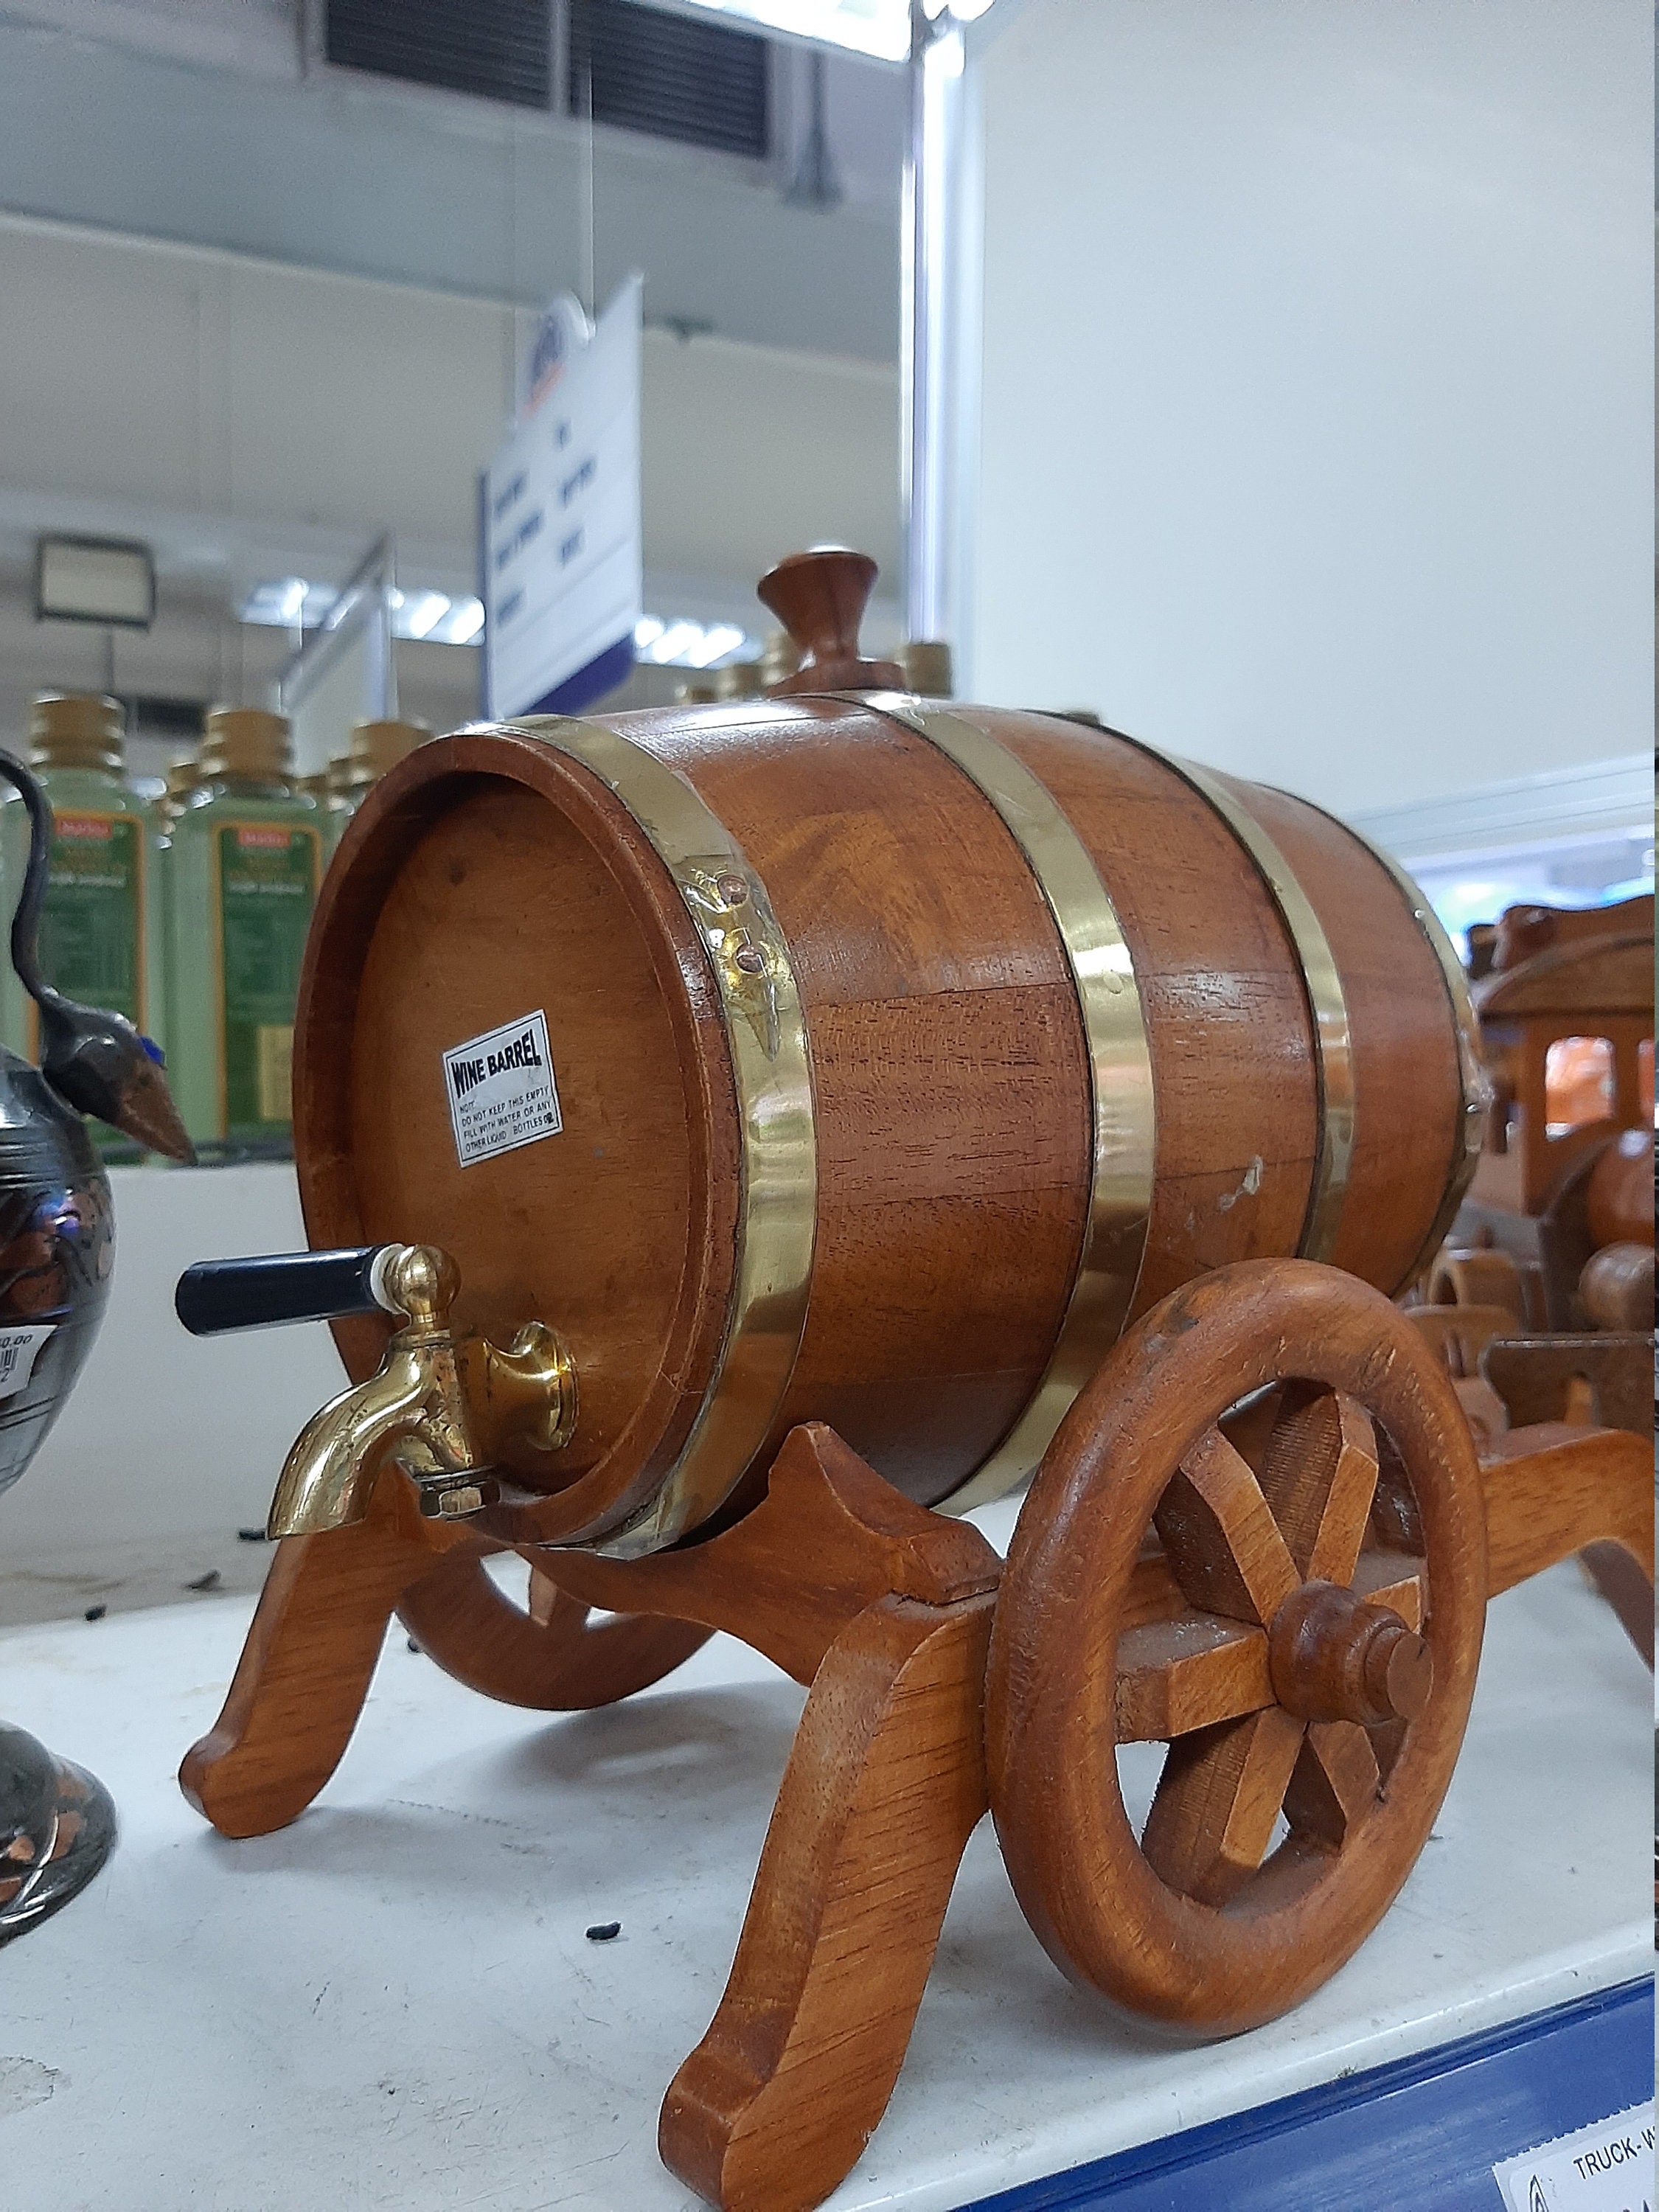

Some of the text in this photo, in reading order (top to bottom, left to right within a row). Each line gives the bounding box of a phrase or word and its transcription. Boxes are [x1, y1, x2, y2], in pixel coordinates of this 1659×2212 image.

[451, 1029, 542, 1099] WINE BARREL
[462, 1085, 549, 1127] DO NOT KEEP THIS EMPTY
[464, 1100, 552, 1139] FILL WITH WATER OR ANY
[465, 1137, 487, 1152] OTHER
[513, 1116, 543, 1135] BOTTLES
